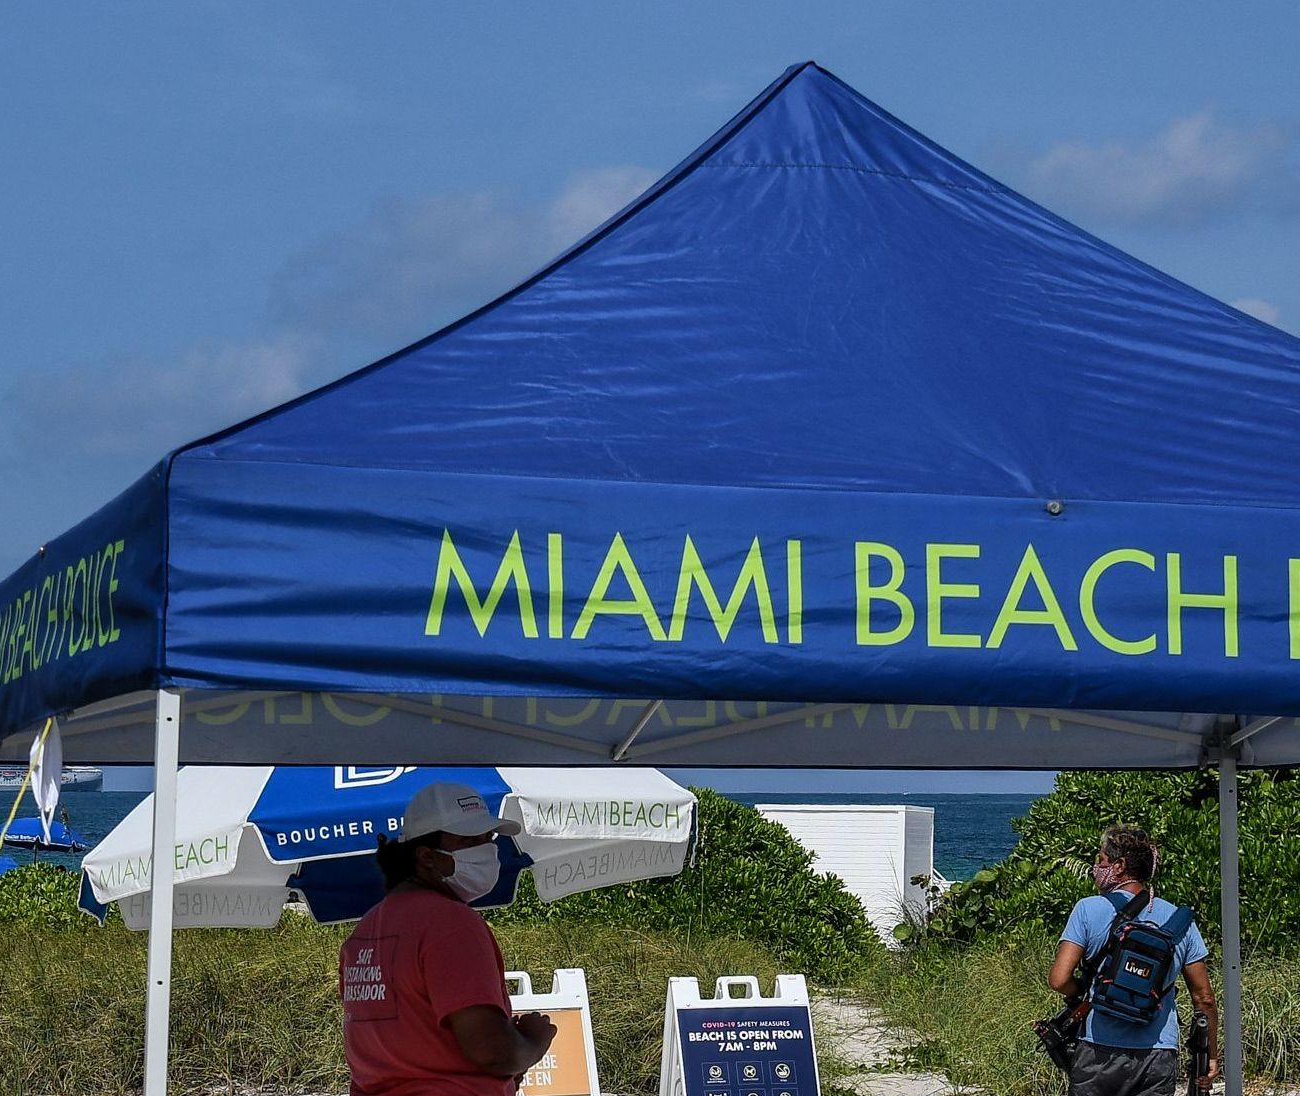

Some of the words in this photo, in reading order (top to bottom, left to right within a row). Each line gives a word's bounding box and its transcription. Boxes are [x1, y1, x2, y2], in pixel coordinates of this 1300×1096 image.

[424, 527, 803, 645] MIAMI
[855, 541, 1240, 658] BEACH
[4, 571, 62, 685] BEACH
[55, 539, 125, 661] POLICE
[536, 800, 681, 830] MIAMIBEACH
[276, 820, 374, 847] BOUCHER
[1124, 960, 1150, 978] LiveU
[702, 1021, 736, 1029] COVID-19
[736, 1020, 758, 1028] SAFETY
[759, 1020, 791, 1028] MEASURES
[688, 1030, 725, 1042] BEACH
[726, 1030, 737, 1041] IS
[739, 1029, 770, 1041] OPEN
[772, 1028, 804, 1040] FROM
[718, 1041, 745, 1052] 7AM
[753, 1040, 778, 1051] 8PM
[536, 1070, 552, 1086] EN
